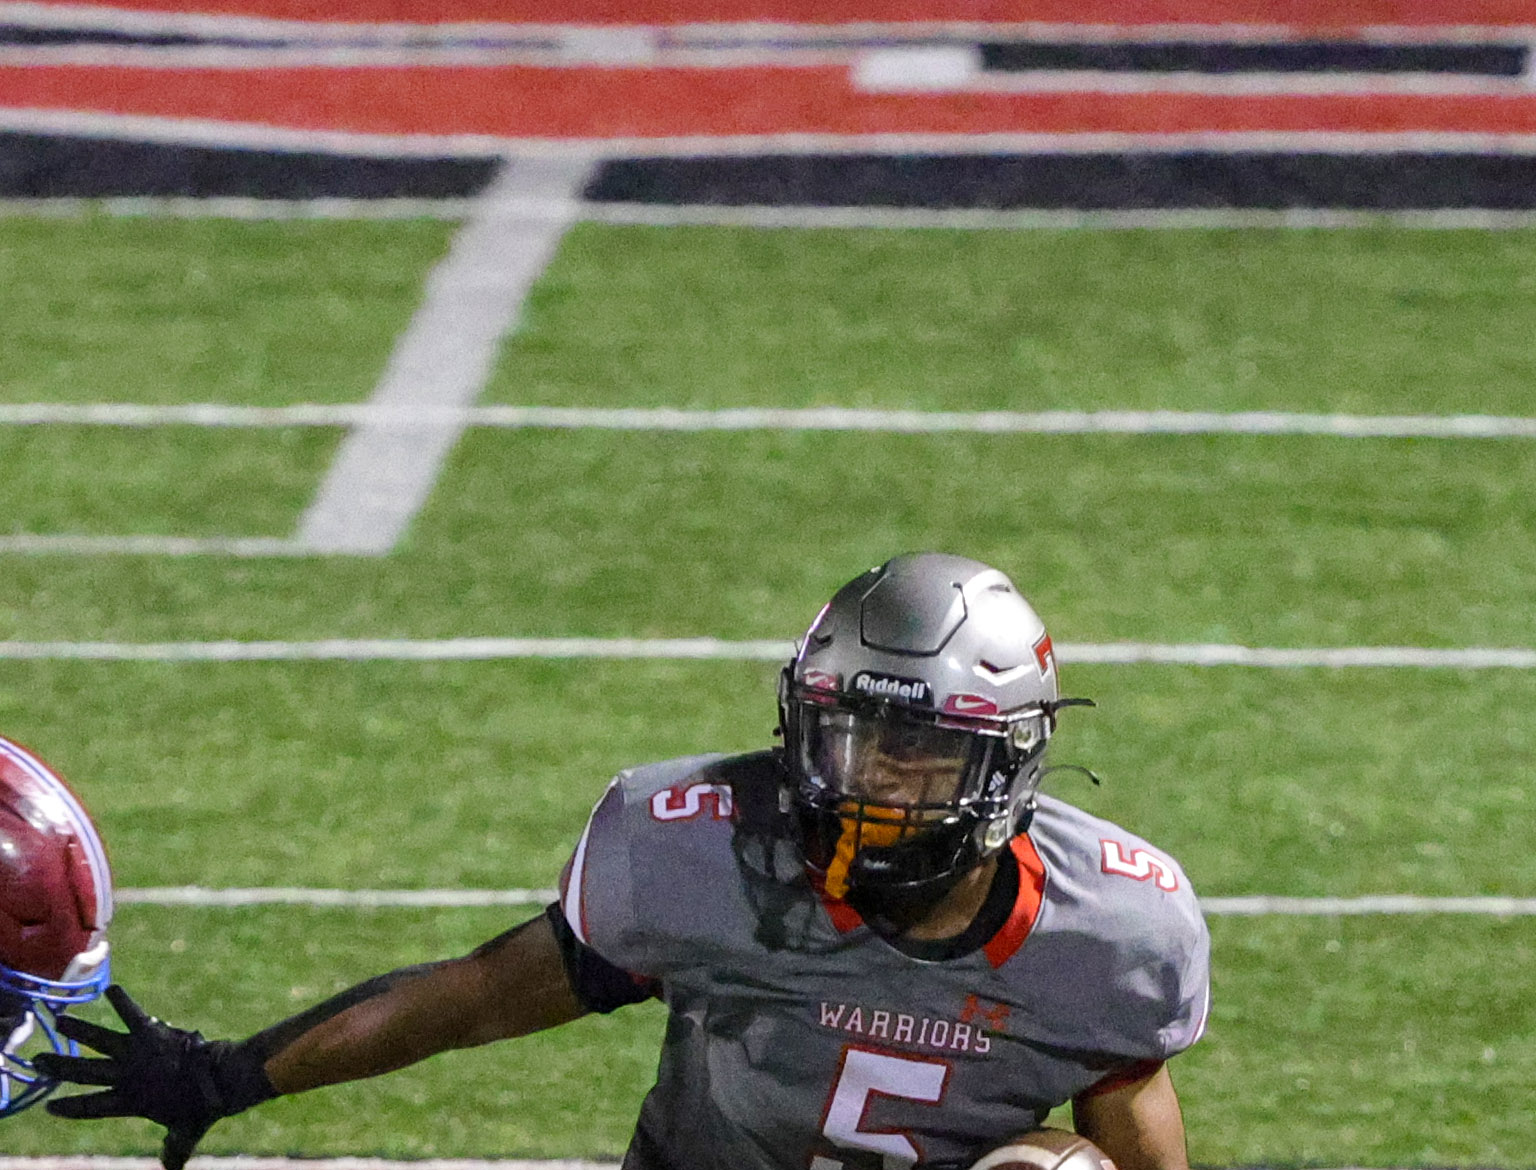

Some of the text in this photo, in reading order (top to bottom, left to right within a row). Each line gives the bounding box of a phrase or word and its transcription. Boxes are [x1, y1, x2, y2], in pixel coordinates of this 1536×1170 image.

[856, 673, 925, 699] Riddell
[650, 781, 734, 821] 5
[1098, 838, 1179, 893] 5
[819, 1002, 992, 1053] WARRIORS
